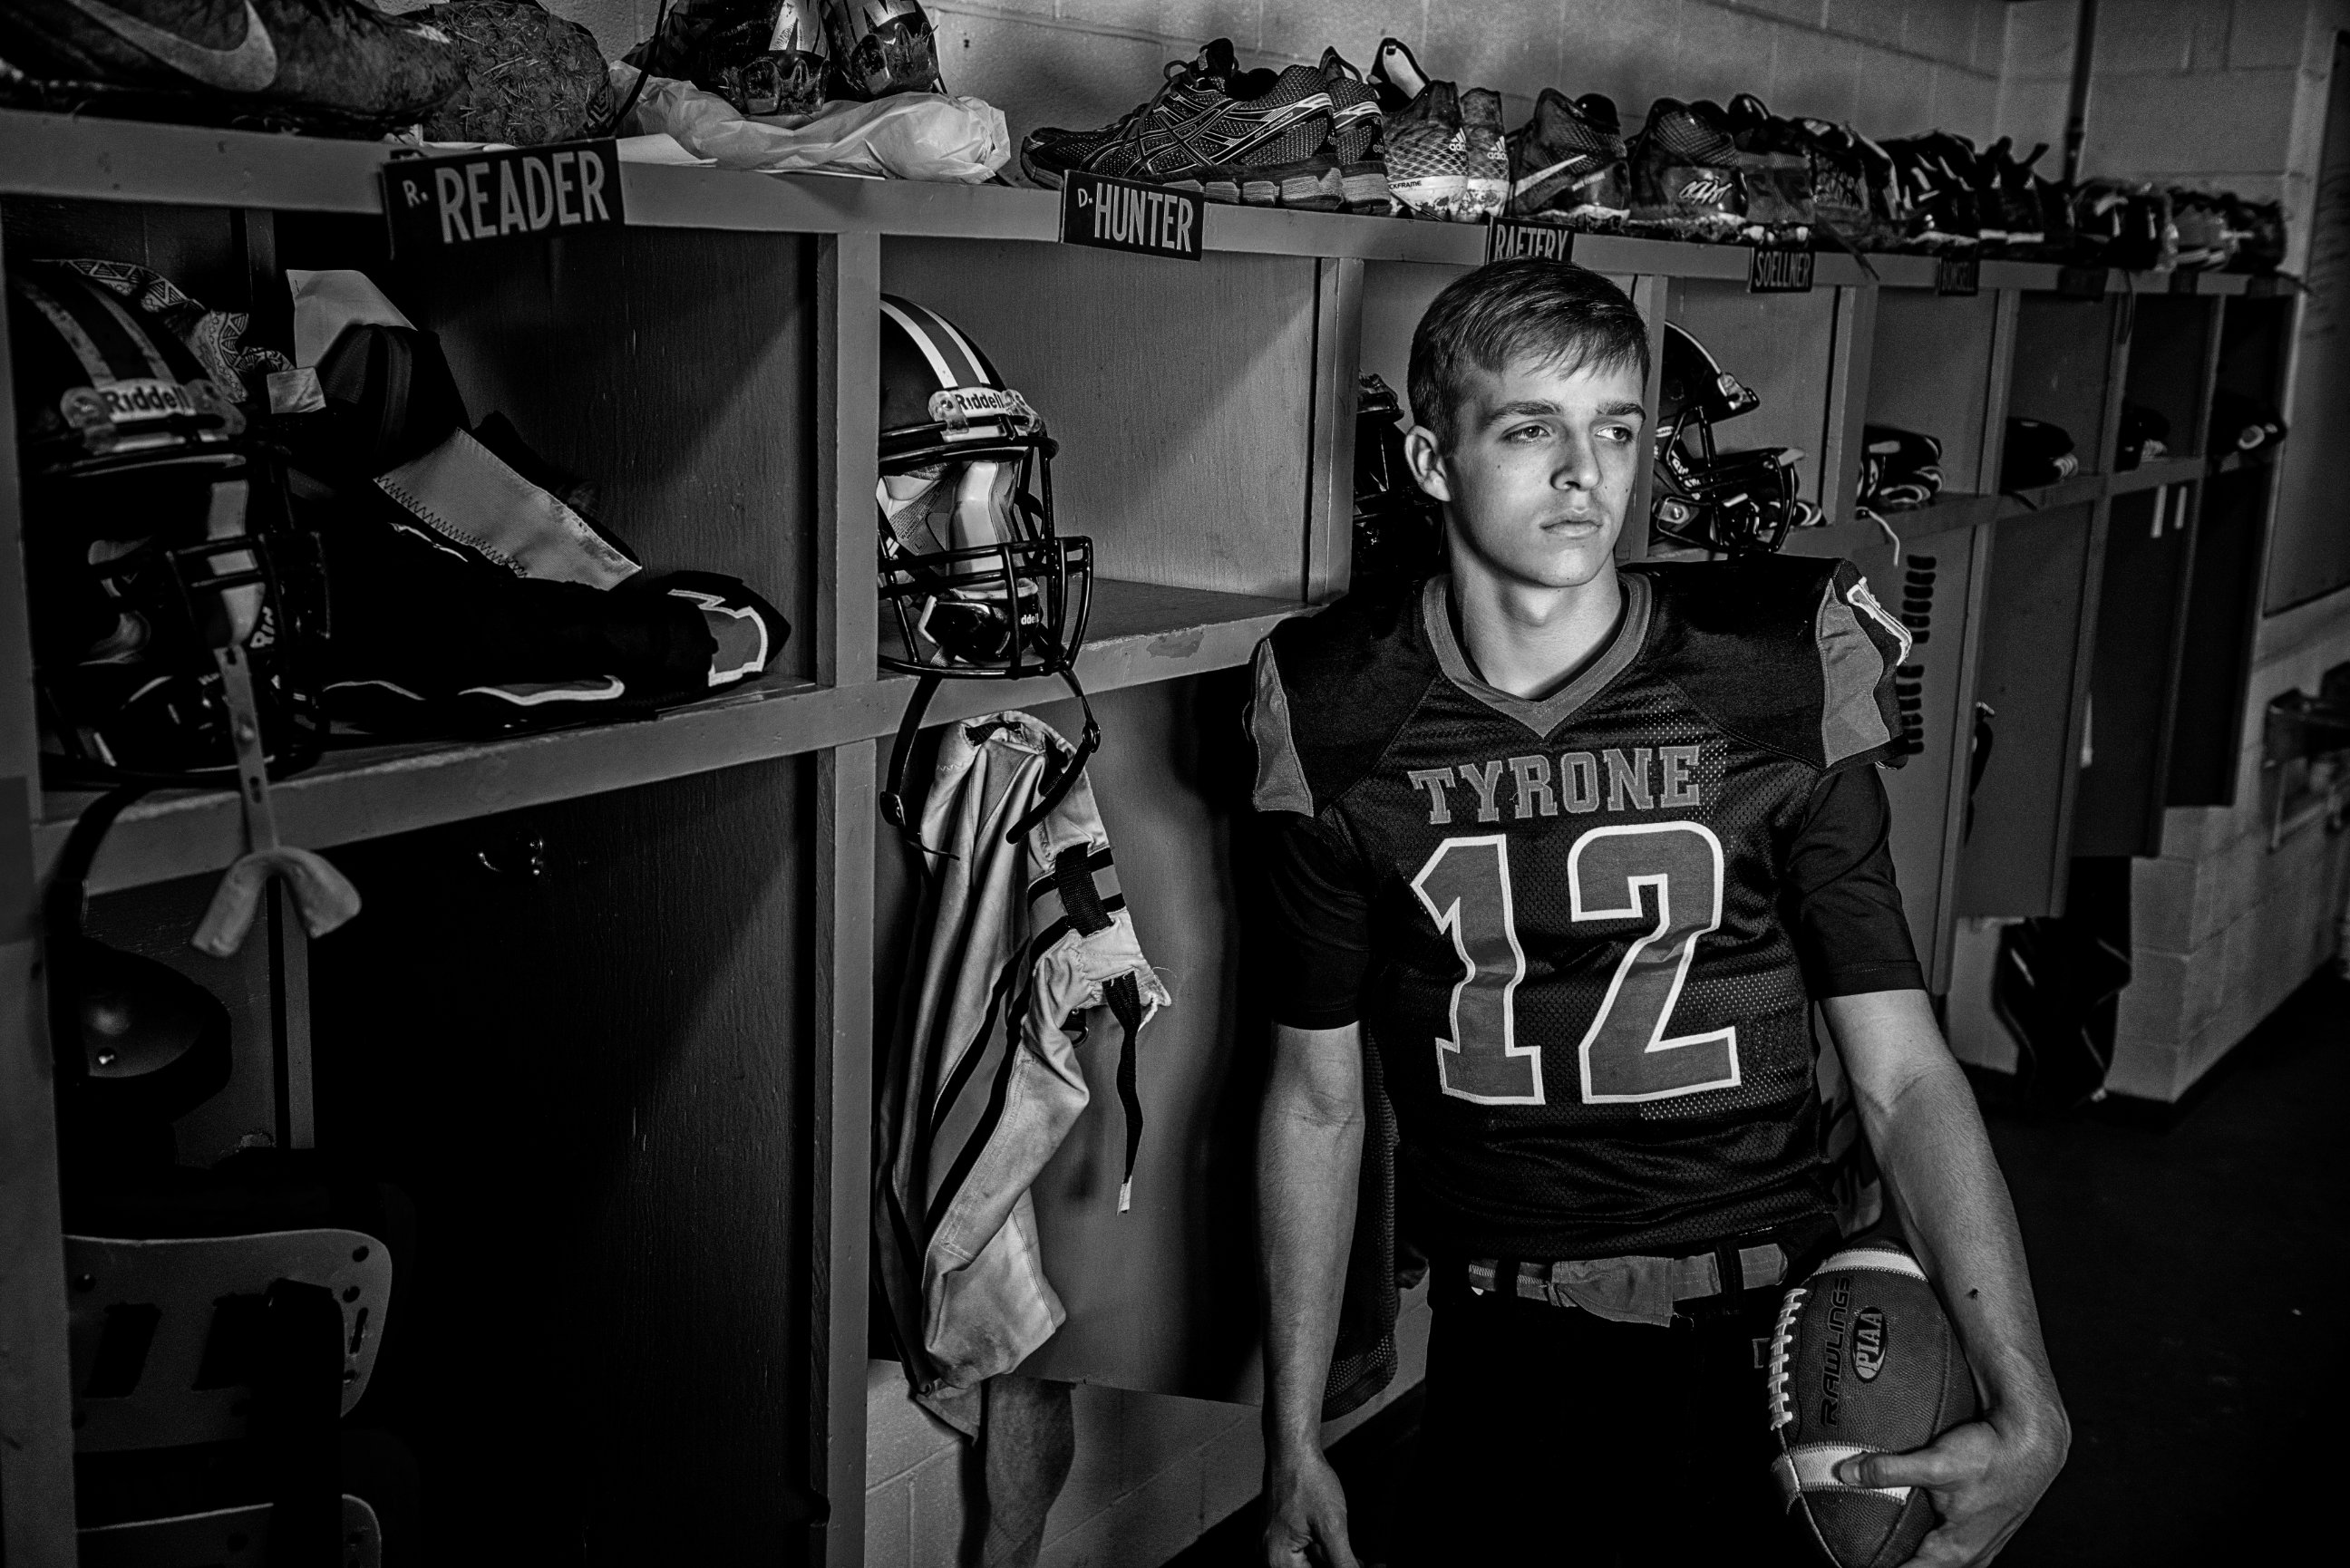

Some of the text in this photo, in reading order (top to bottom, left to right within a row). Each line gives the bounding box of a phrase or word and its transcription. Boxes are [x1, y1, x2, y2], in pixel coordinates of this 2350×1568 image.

[1449, 142, 1466, 151] adid
[434, 149, 610, 245] READER
[1094, 182, 1194, 253] HUNTER
[100, 386, 191, 413] Riddell
[955, 392, 1005, 411] Riddell
[1020, 612, 1040, 625] ddell
[1407, 745, 1701, 825] TYRONE
[1410, 820, 1742, 1106] 12
[1821, 1277, 1850, 1427] RAWLINGS
[1855, 1312, 1883, 1371] PIAA
